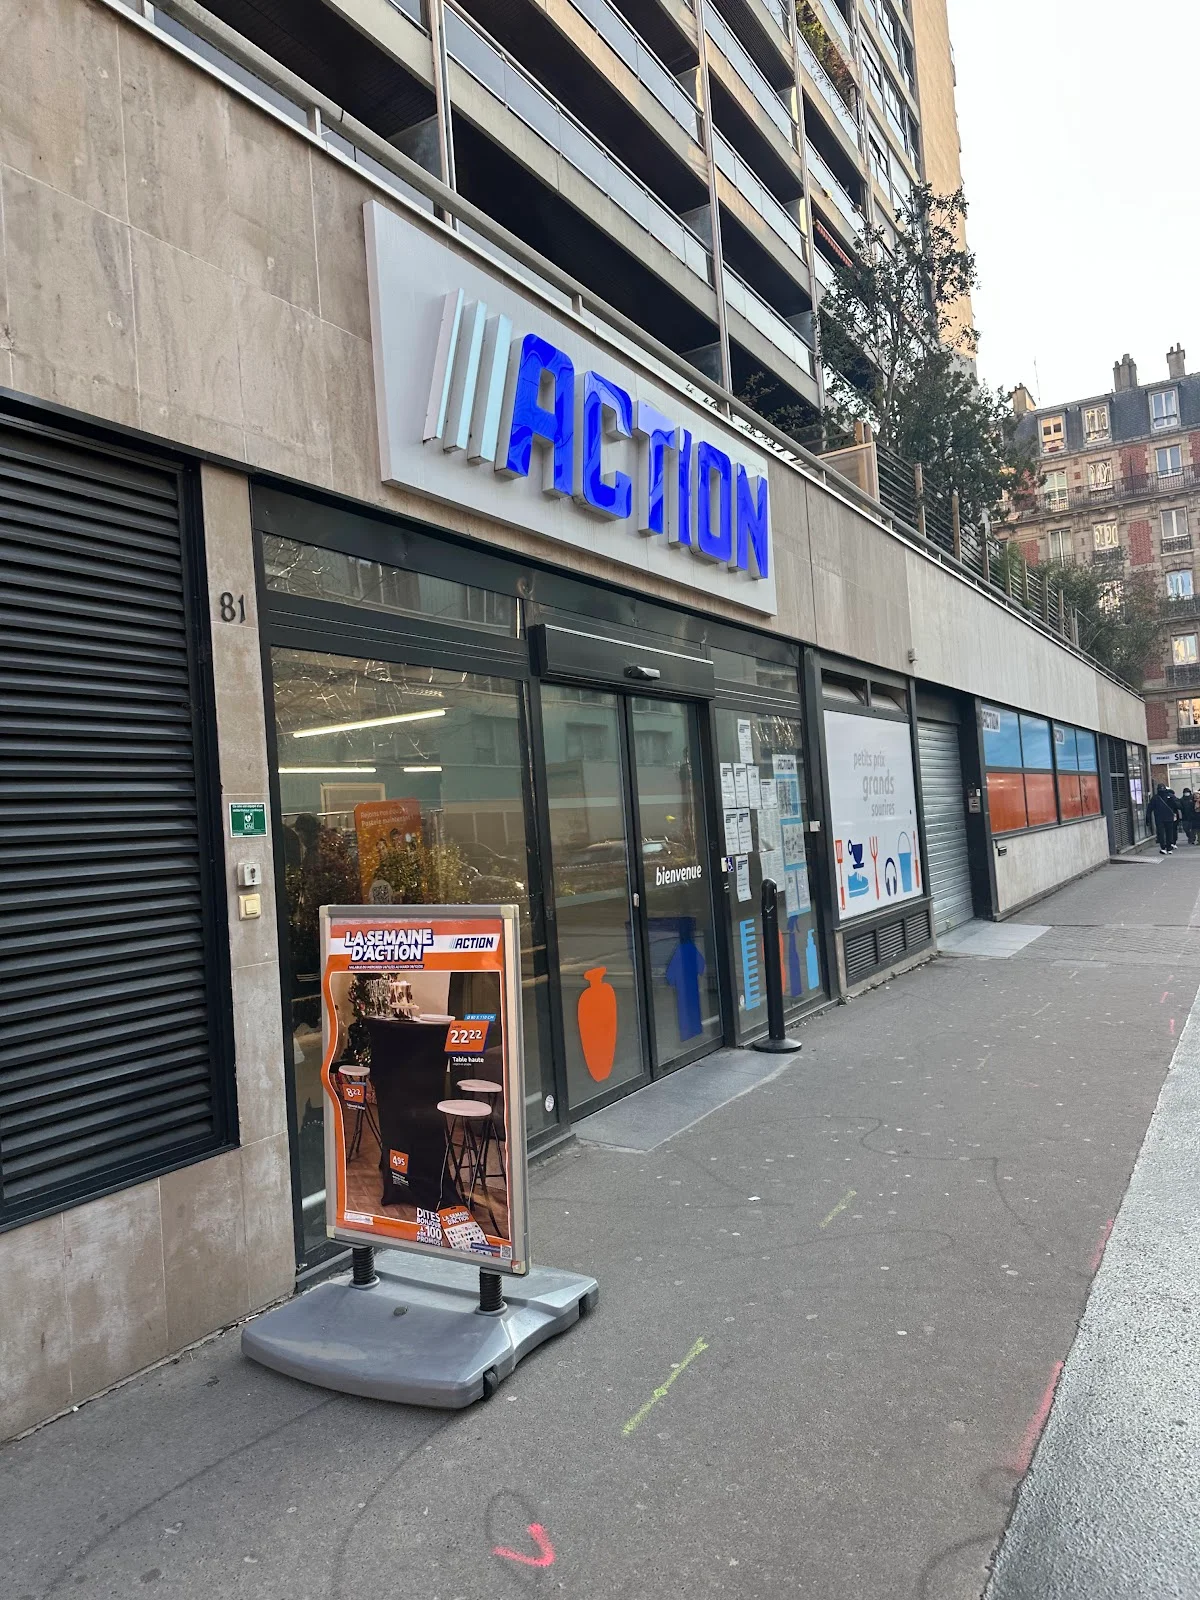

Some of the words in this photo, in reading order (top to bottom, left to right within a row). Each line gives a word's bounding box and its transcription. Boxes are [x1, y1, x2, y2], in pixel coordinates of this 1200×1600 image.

[502, 333, 768, 579] ACTION
[220, 591, 246, 624] 81
[853, 750, 873, 770] petits
[873, 750, 885, 772] prix
[863, 769, 895, 802] grands
[656, 865, 702, 886] bienvenue
[345, 931, 364, 946] LA
[366, 929, 432, 946] SEMAINE
[454, 937, 494, 949] ACTION
[351, 945, 423, 961] D'ACTION
[416, 1207, 441, 1223] DITES
[426, 1225, 443, 1241] 100
